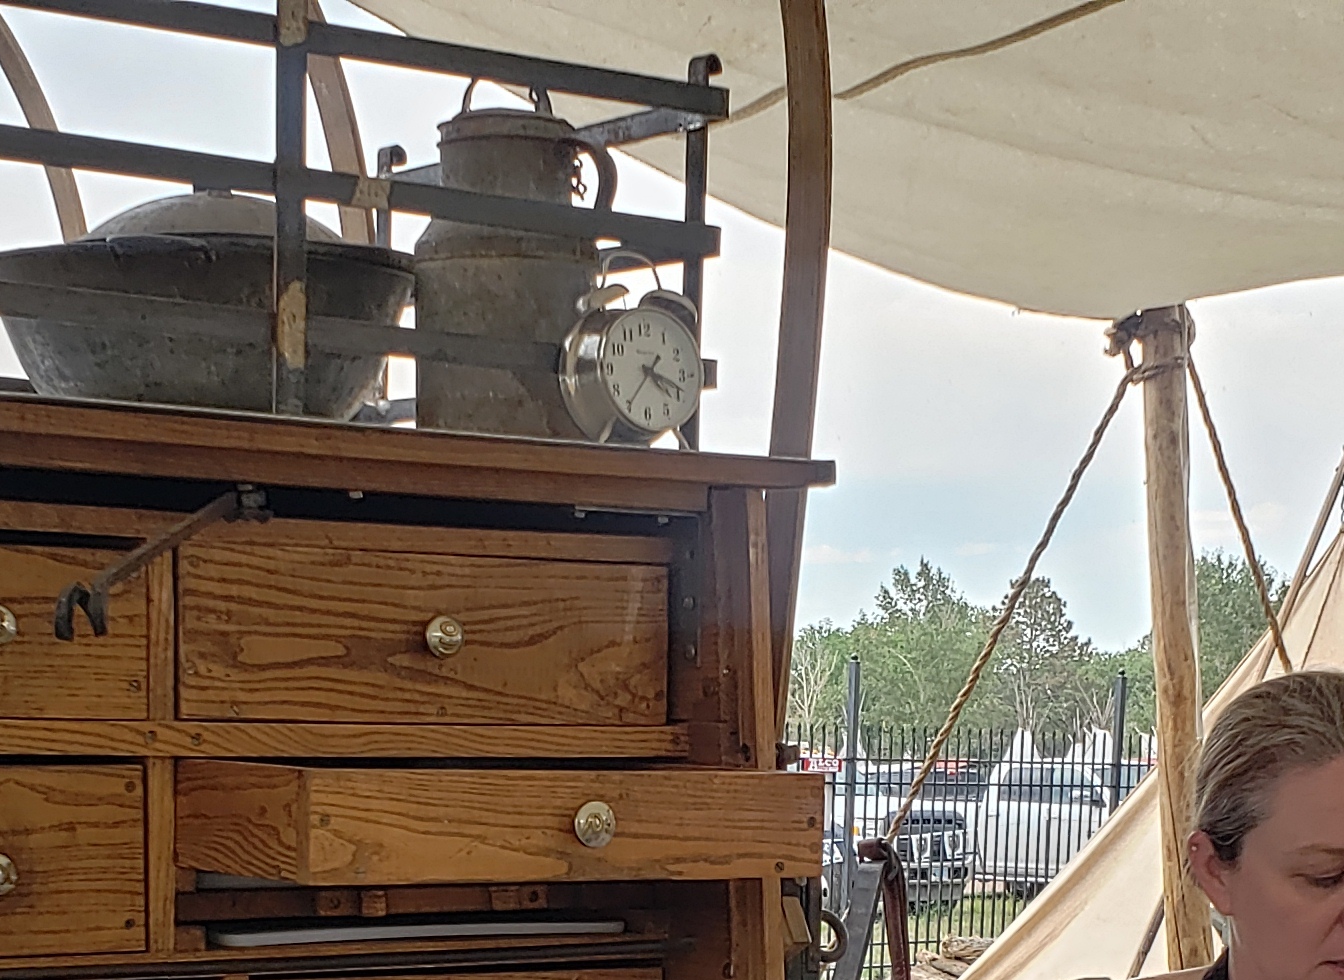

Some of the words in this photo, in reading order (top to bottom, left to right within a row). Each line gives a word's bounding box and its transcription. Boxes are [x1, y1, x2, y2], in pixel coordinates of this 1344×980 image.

[623, 328, 633, 342] 11
[638, 323, 651, 338] 12
[612, 343, 624, 356] 10
[673, 348, 680, 362] 2
[607, 363, 613, 376] 9
[679, 369, 686, 383] 3
[613, 384, 620, 397] 8
[644, 407, 652, 420] 6
[663, 403, 669, 417] 5
[808, 758, 840, 771] ALCO
